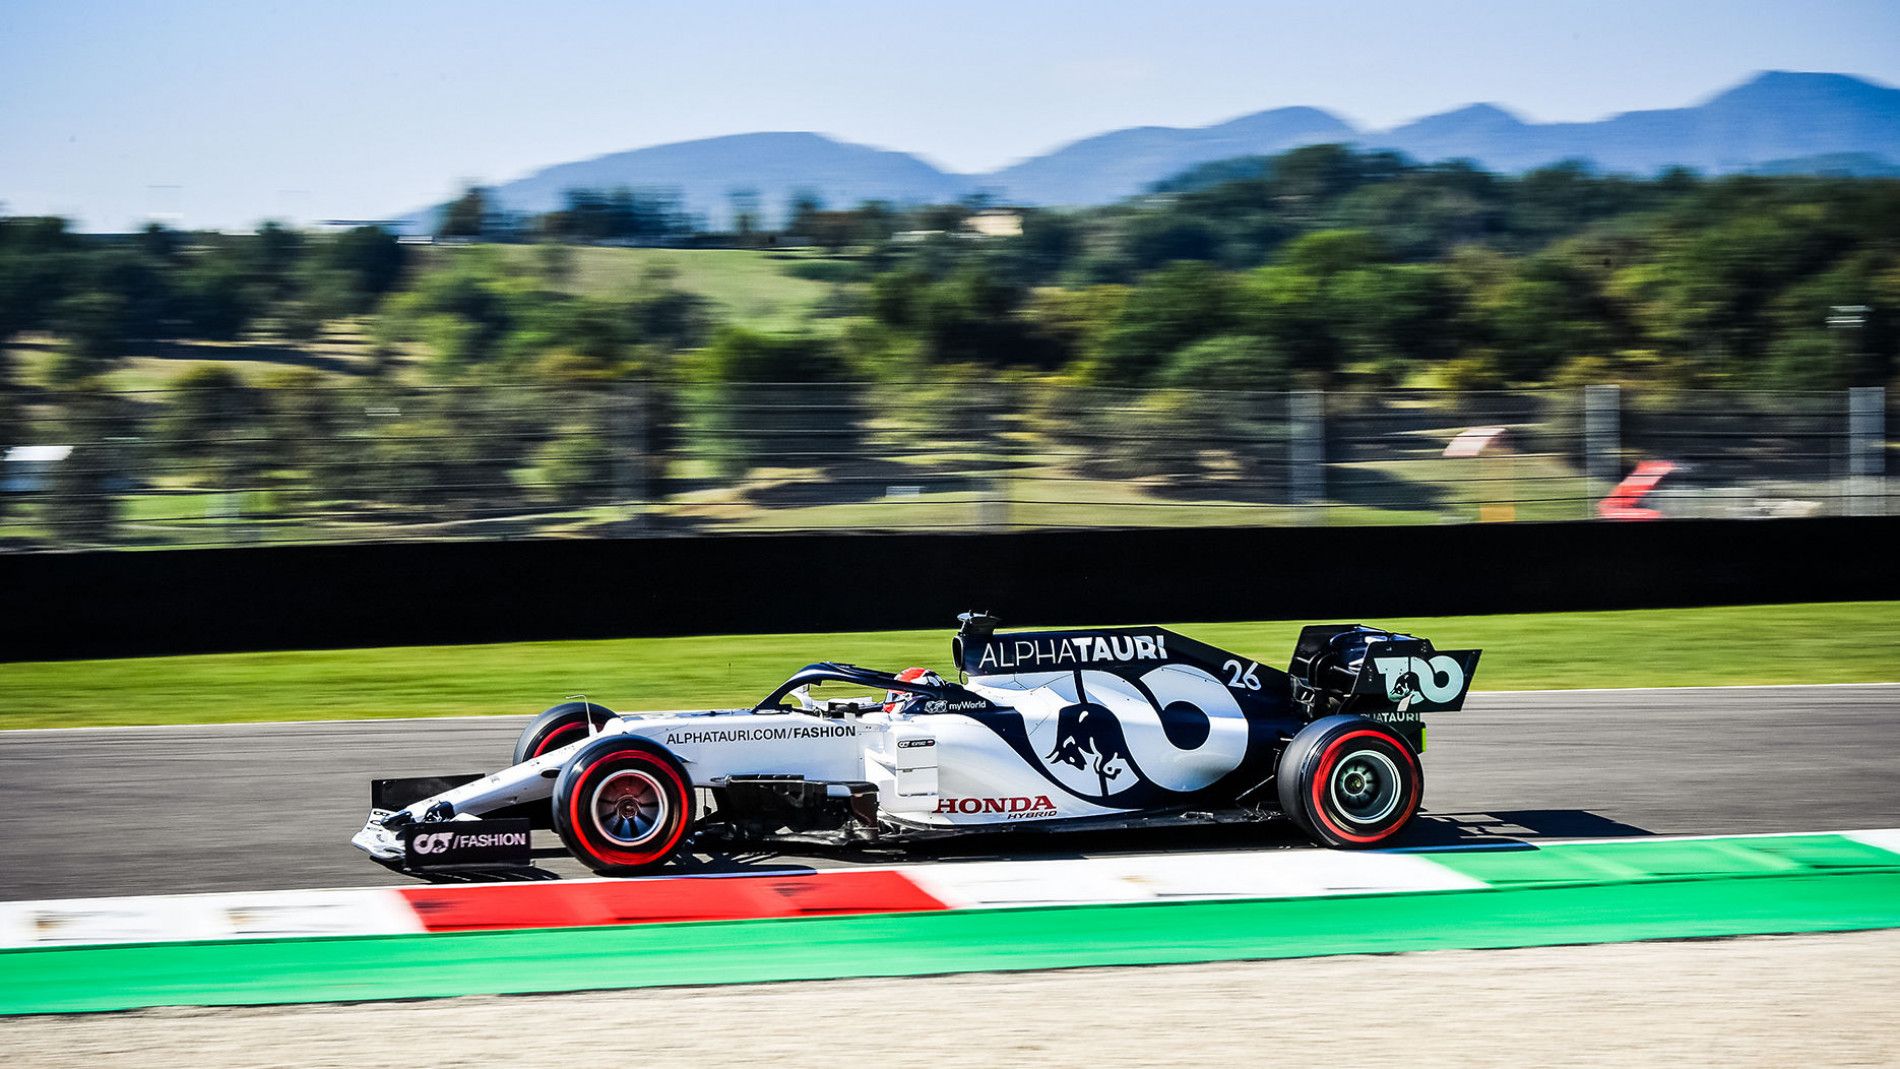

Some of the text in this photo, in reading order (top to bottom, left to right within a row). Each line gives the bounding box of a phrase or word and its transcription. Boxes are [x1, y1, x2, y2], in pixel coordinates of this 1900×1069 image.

[978, 635, 1168, 669] ALPHATAURI
[1223, 660, 1262, 690] 26
[949, 701, 986, 710] myWorld
[666, 726, 856, 745] ALPHATAURI.COM/FASHION
[931, 795, 1057, 814] HONDA
[1007, 810, 1058, 819] HYBRID
